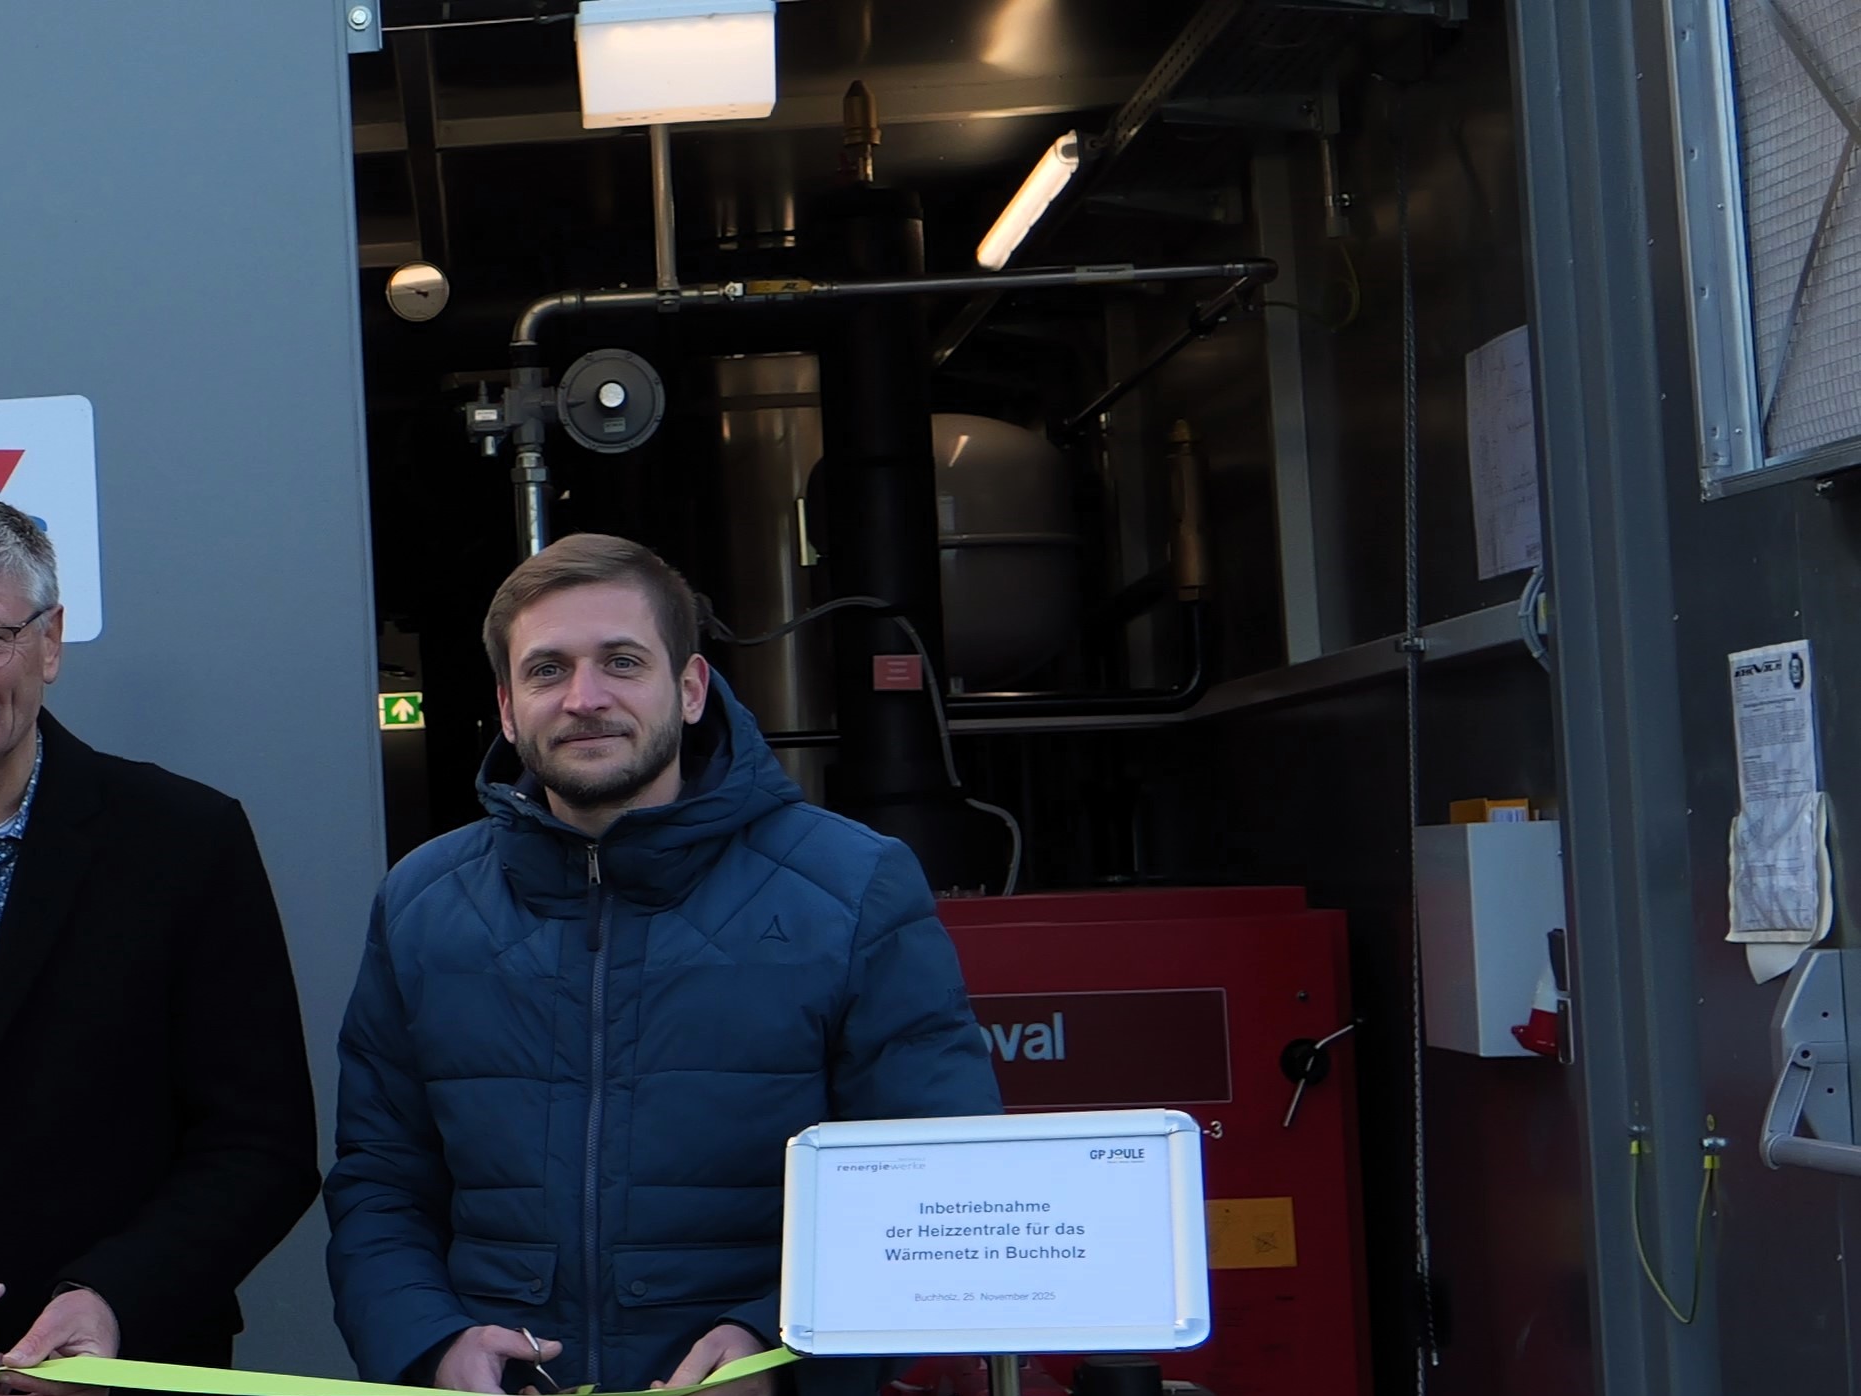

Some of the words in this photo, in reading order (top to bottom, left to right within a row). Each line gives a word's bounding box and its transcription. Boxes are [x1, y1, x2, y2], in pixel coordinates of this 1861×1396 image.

[1089, 1148, 1106, 1160] GP
[1106, 1147, 1145, 1159] JOULE
[836, 1161, 926, 1173] renergiewerke
[919, 1200, 1051, 1215] Inbetriebnahme
[885, 1224, 912, 1238] der
[918, 1222, 1021, 1237] Heizzentrale
[1025, 1221, 1050, 1236] für
[1055, 1221, 1085, 1235] das
[885, 1247, 979, 1262] Wärmenetz
[984, 1245, 1000, 1260] in
[1005, 1245, 1087, 1260] Buchholz
[980, 1291, 1029, 1301] November
[1032, 1291, 1057, 1301] 2025
